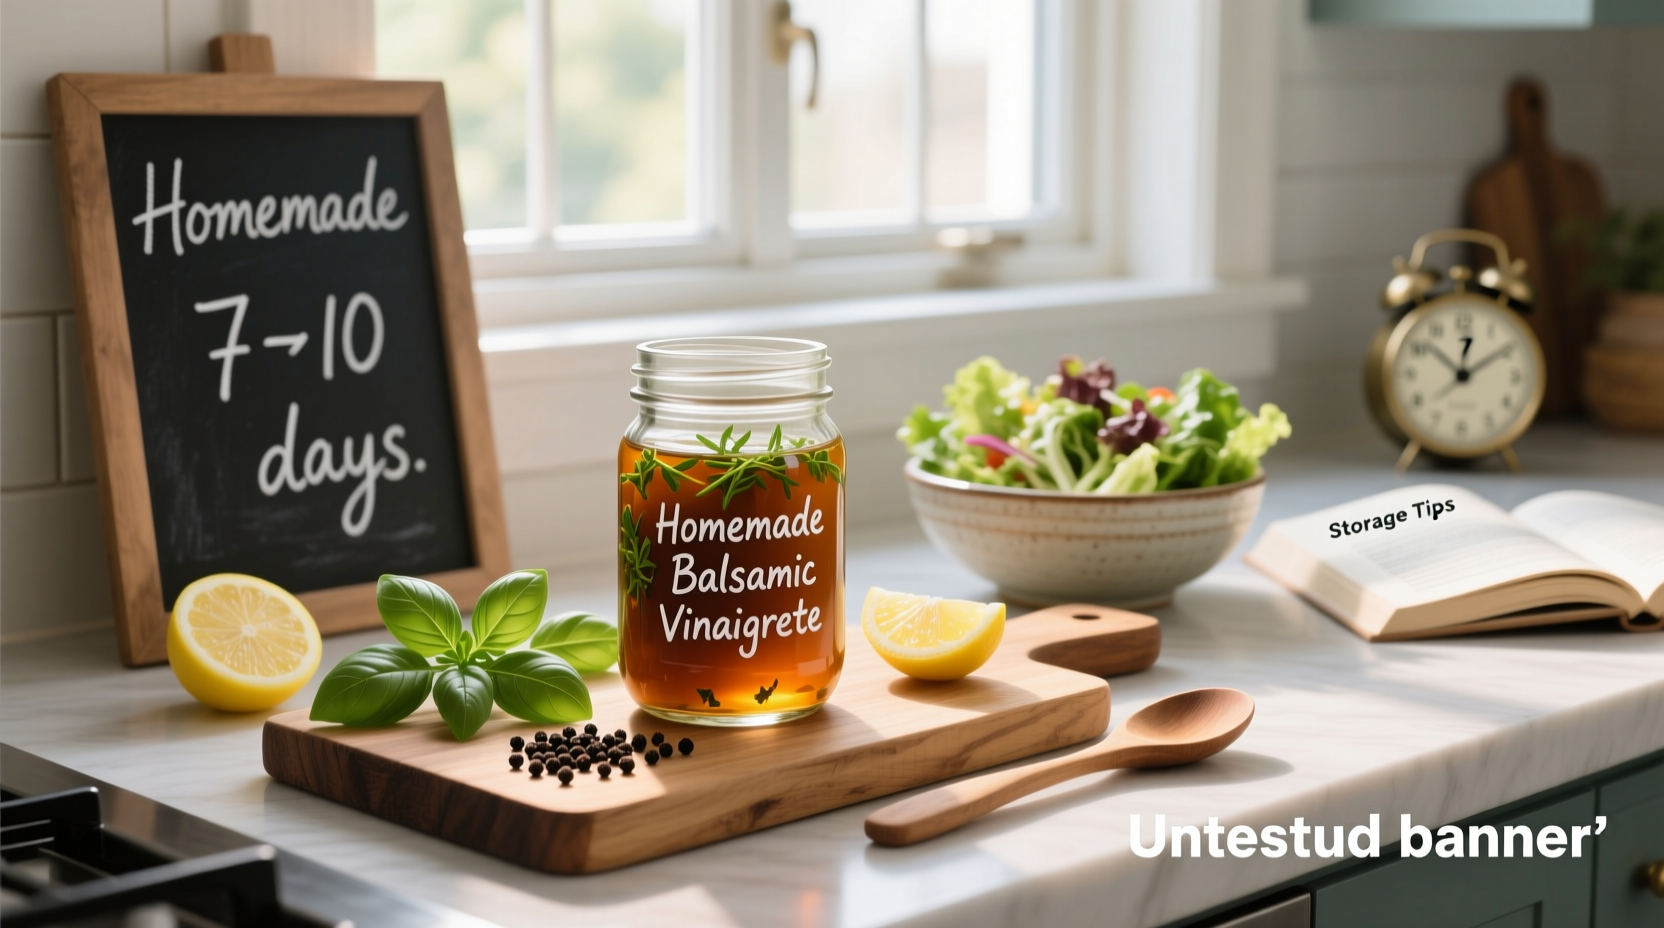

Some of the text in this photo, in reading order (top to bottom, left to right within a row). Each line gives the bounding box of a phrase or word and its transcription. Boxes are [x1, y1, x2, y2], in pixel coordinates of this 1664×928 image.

[132, 155, 409, 256] Homemade
[257, 402, 427, 536] days.
[656, 494, 824, 544] Homemade
[1329, 498, 1456, 539] Storage Tips
[672, 552, 817, 595] Balsamic
[659, 598, 822, 658] Vinaigrete
